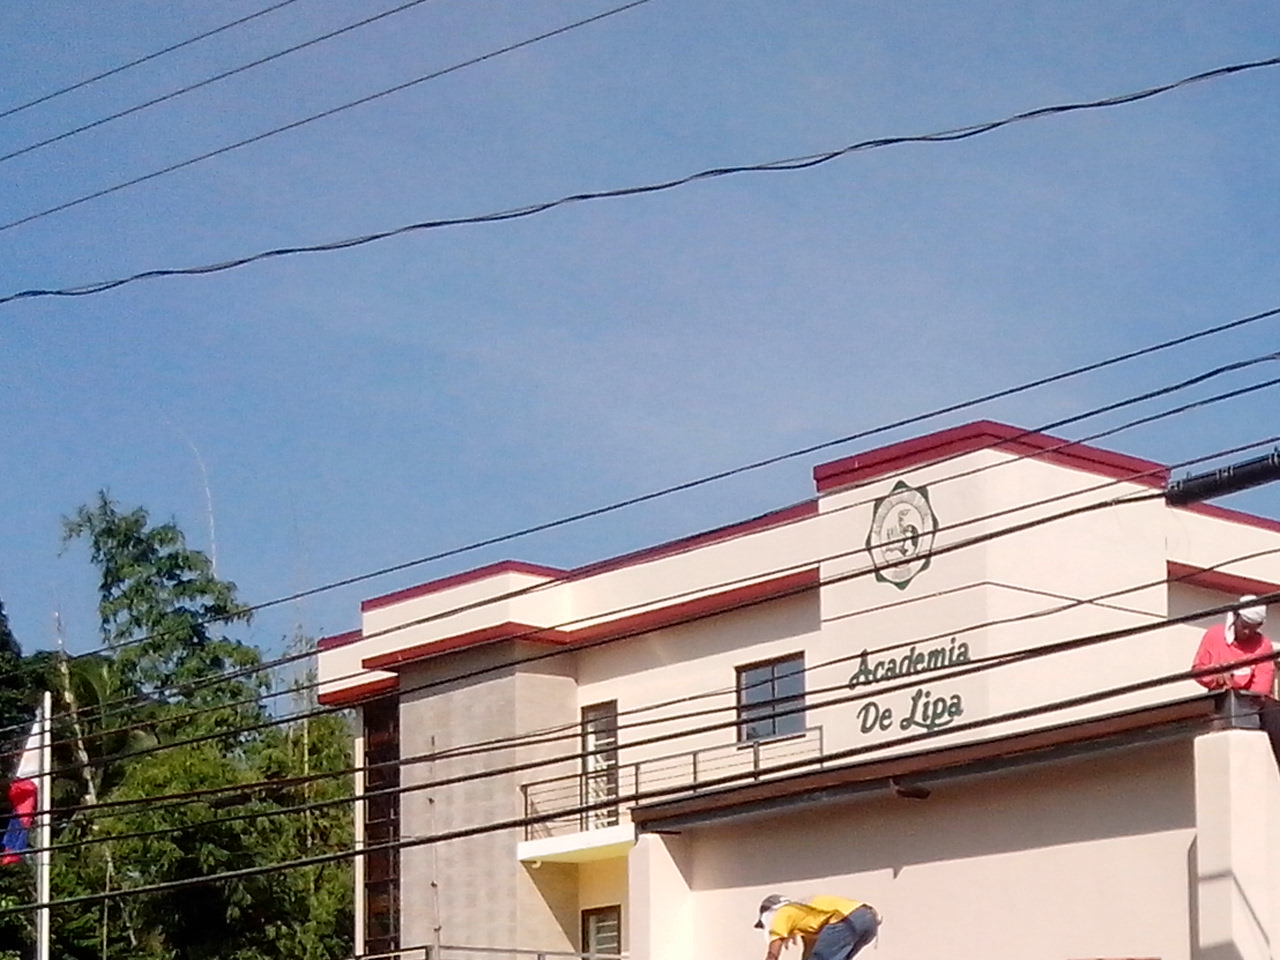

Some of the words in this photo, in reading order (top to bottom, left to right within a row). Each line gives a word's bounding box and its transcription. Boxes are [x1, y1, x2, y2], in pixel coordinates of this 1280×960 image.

[849, 637, 971, 689] Academia
[857, 701, 893, 734] De
[900, 689, 964, 733] Lipa
